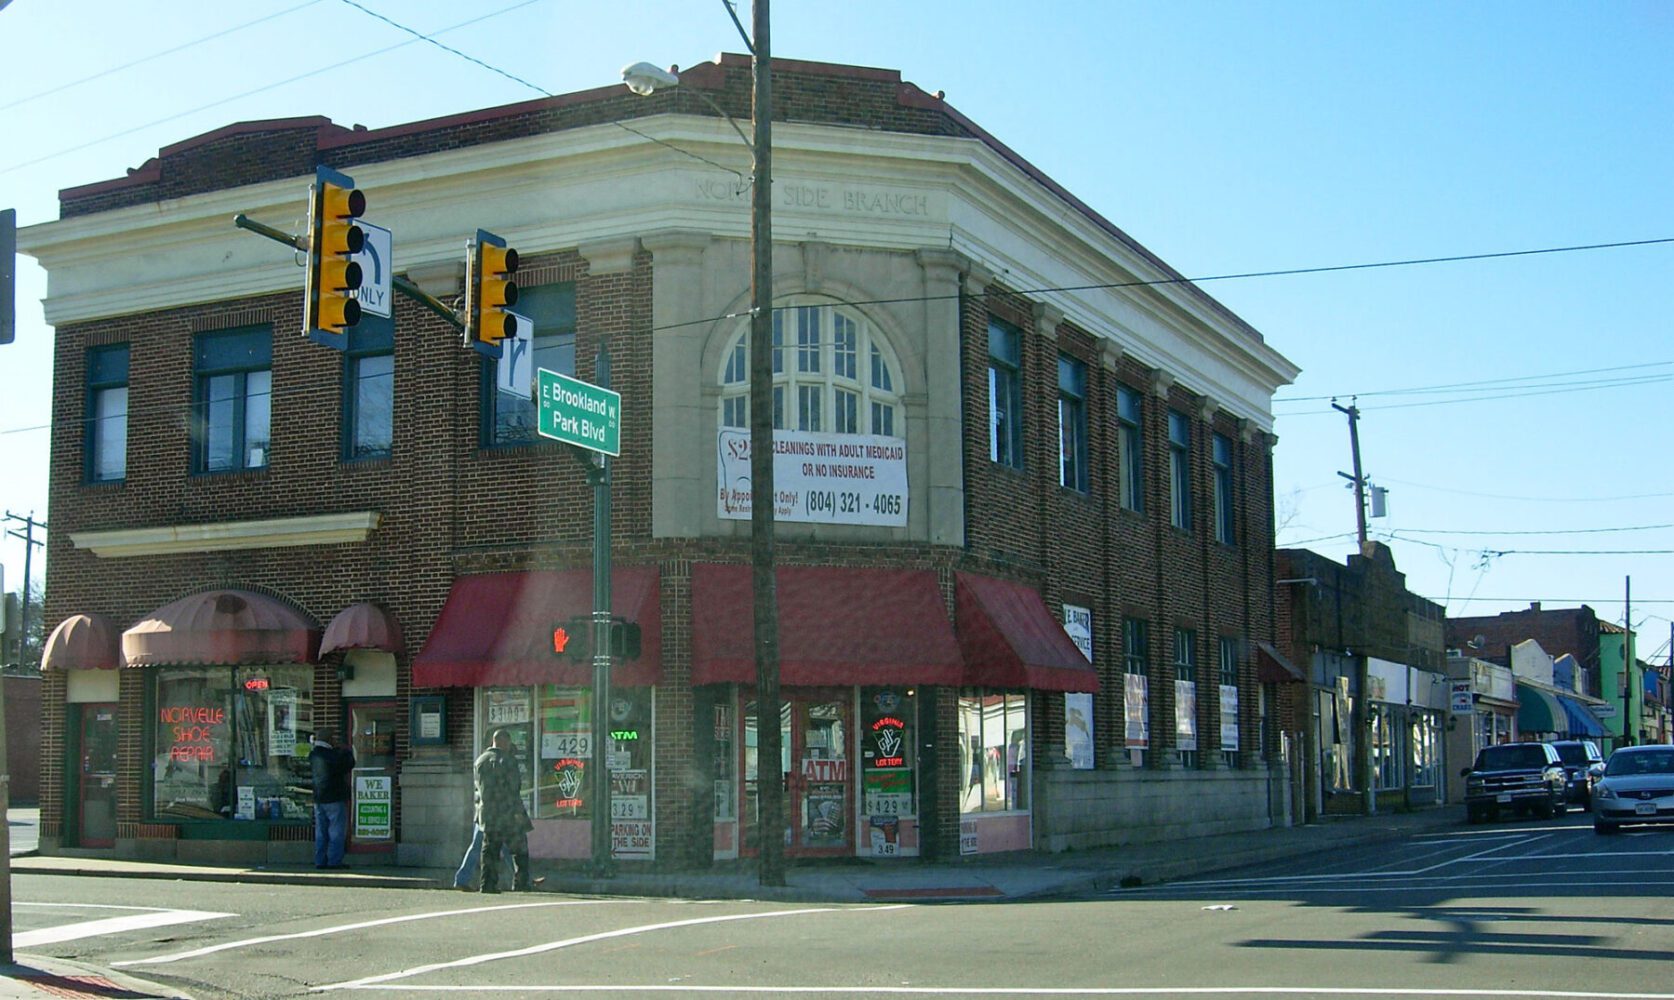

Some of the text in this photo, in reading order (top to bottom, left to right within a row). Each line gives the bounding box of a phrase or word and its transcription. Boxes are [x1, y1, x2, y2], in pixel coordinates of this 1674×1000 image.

[783, 184, 831, 209] SIDE
[843, 190, 929, 216] BRANCH
[553, 382, 606, 416] Brookland
[553, 410, 606, 442] Park Blvd
[816, 442, 837, 457] WITH
[839, 444, 864, 459] ADULT
[866, 445, 904, 461] MEDICAID
[802, 462, 876, 480] OR NO INSURANCE
[779, 490, 799, 507] Only!
[805, 490, 836, 518] (804)
[840, 491, 860, 513] 321
[873, 493, 901, 515] 4065
[244, 679, 269, 690] OPEN
[160, 706, 224, 724] NORVELLE
[173, 726, 211, 743] SHOE
[170, 745, 214, 763] REPAIR
[806, 760, 846, 781] ATM
[357, 790, 390, 800] BAKER
[612, 836, 650, 848] THE SIDE
